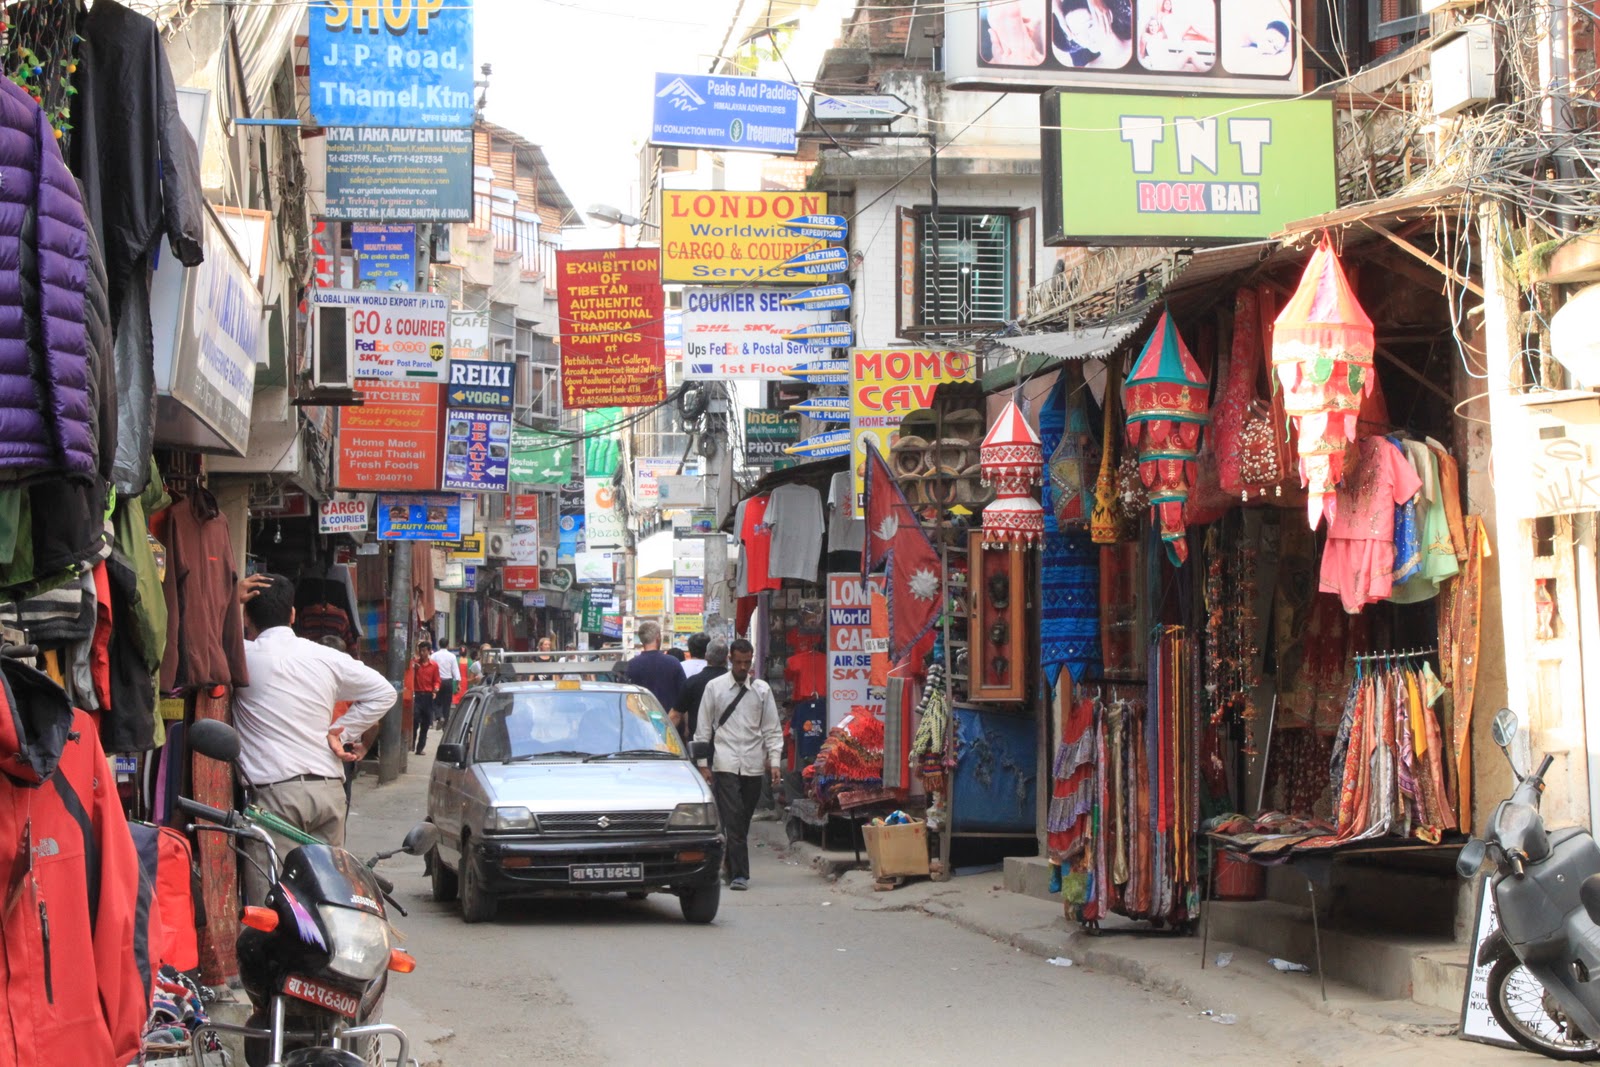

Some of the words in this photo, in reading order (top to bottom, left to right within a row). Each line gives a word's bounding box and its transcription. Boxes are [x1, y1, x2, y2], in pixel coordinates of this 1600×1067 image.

[325, 0, 443, 36] SHOP
[708, 80, 736, 97] Peaks
[738, 83, 757, 98] And
[759, 82, 797, 101] Paddles
[714, 102, 747, 112] HIMALAYAN
[747, 104, 786, 115] ADVENTURES
[654, 124, 662, 133] IN
[663, 125, 707, 136] CONJUCTION
[708, 127, 725, 137] WITH
[746, 122, 795, 144] treejumpers
[1119, 115, 1272, 175] TNT
[1139, 182, 1206, 212] ROCK
[1211, 184, 1258, 212] BAR
[671, 194, 820, 218] LONDON
[448, 208, 469, 219] INDIA
[807, 215, 836, 226] TREKS
[801, 229, 842, 239] EXPEDITIONS
[603, 252, 616, 260] AN
[667, 241, 723, 261] CARGO
[730, 243, 742, 261] &
[805, 249, 840, 261] RAFTING
[566, 259, 658, 274] EXHIBITION
[692, 265, 798, 278] Service
[804, 261, 846, 275] KAYAKING
[601, 273, 622, 284] OF
[568, 284, 628, 297] TIBETAN
[809, 287, 843, 297] TOURS
[314, 294, 342, 304] GLOBAL
[344, 295, 361, 305] LINK
[362, 296, 388, 306] WORLD
[390, 297, 417, 308] EXPORT
[419, 299, 429, 309] (P)
[431, 299, 446, 309] LTD.
[570, 296, 643, 309] AUTHENTIC
[689, 293, 755, 312] COURIER
[759, 293, 804, 312] SERV
[570, 308, 653, 321] TRADITIONAL
[384, 318, 392, 335] &
[396, 319, 445, 337] COURIER
[452, 316, 488, 328] CAFE
[571, 321, 632, 333] THANGKA
[690, 324, 738, 333] DHL
[452, 338, 473, 349] AR
[571, 333, 642, 345] PAINTINGS
[355, 339, 390, 353] FedEx
[430, 347, 444, 361] ups
[605, 344, 617, 353] at
[688, 343, 706, 358] Ups
[709, 342, 739, 356] FedEx
[742, 343, 750, 355] &
[753, 342, 783, 355] Postal
[786, 341, 824, 355] Service
[397, 359, 411, 368] Post
[412, 360, 432, 368] Parcel
[605, 354, 621, 365] Art
[622, 353, 651, 365] Gallery
[807, 360, 822, 370] MAP
[357, 368, 370, 376] 1st
[372, 368, 393, 376] Floor
[720, 363, 746, 374] 1st
[751, 363, 793, 374] Floor
[855, 352, 970, 381] MOMO
[451, 364, 511, 387] REIKI
[628, 385, 641, 393] ATM
[362, 391, 420, 401] ITCHEN
[466, 391, 500, 404] YOGA
[858, 384, 939, 413] CAV
[349, 406, 425, 417] Continental
[450, 411, 475, 420] HAIR
[477, 413, 509, 421] MOTEL
[809, 411, 822, 419] MT.
[386, 417, 420, 428] Food
[859, 417, 885, 427] HOME
[352, 437, 385, 447] Home
[388, 438, 417, 448] Made
[808, 437, 824, 446] ROCK
[824, 432, 850, 443] CLIMBIN
[344, 448, 383, 460] Typical
[386, 449, 425, 460] Thakali
[350, 460, 381, 470] Fresh
[385, 460, 419, 470] Foods
[510, 457, 539, 467] Upstairs
[356, 473, 372, 482] Tel:
[375, 474, 413, 482] 2040710
[446, 481, 505, 490] PARLOUR
[321, 501, 365, 515] CARGO
[321, 516, 327, 525] &
[329, 514, 365, 525] COURIER
[391, 523, 422, 531] BEAUTY
[424, 523, 448, 531] HOME
[831, 609, 870, 625] World
[834, 655, 871, 667] AIR/SE
[833, 669, 873, 681] SKY
